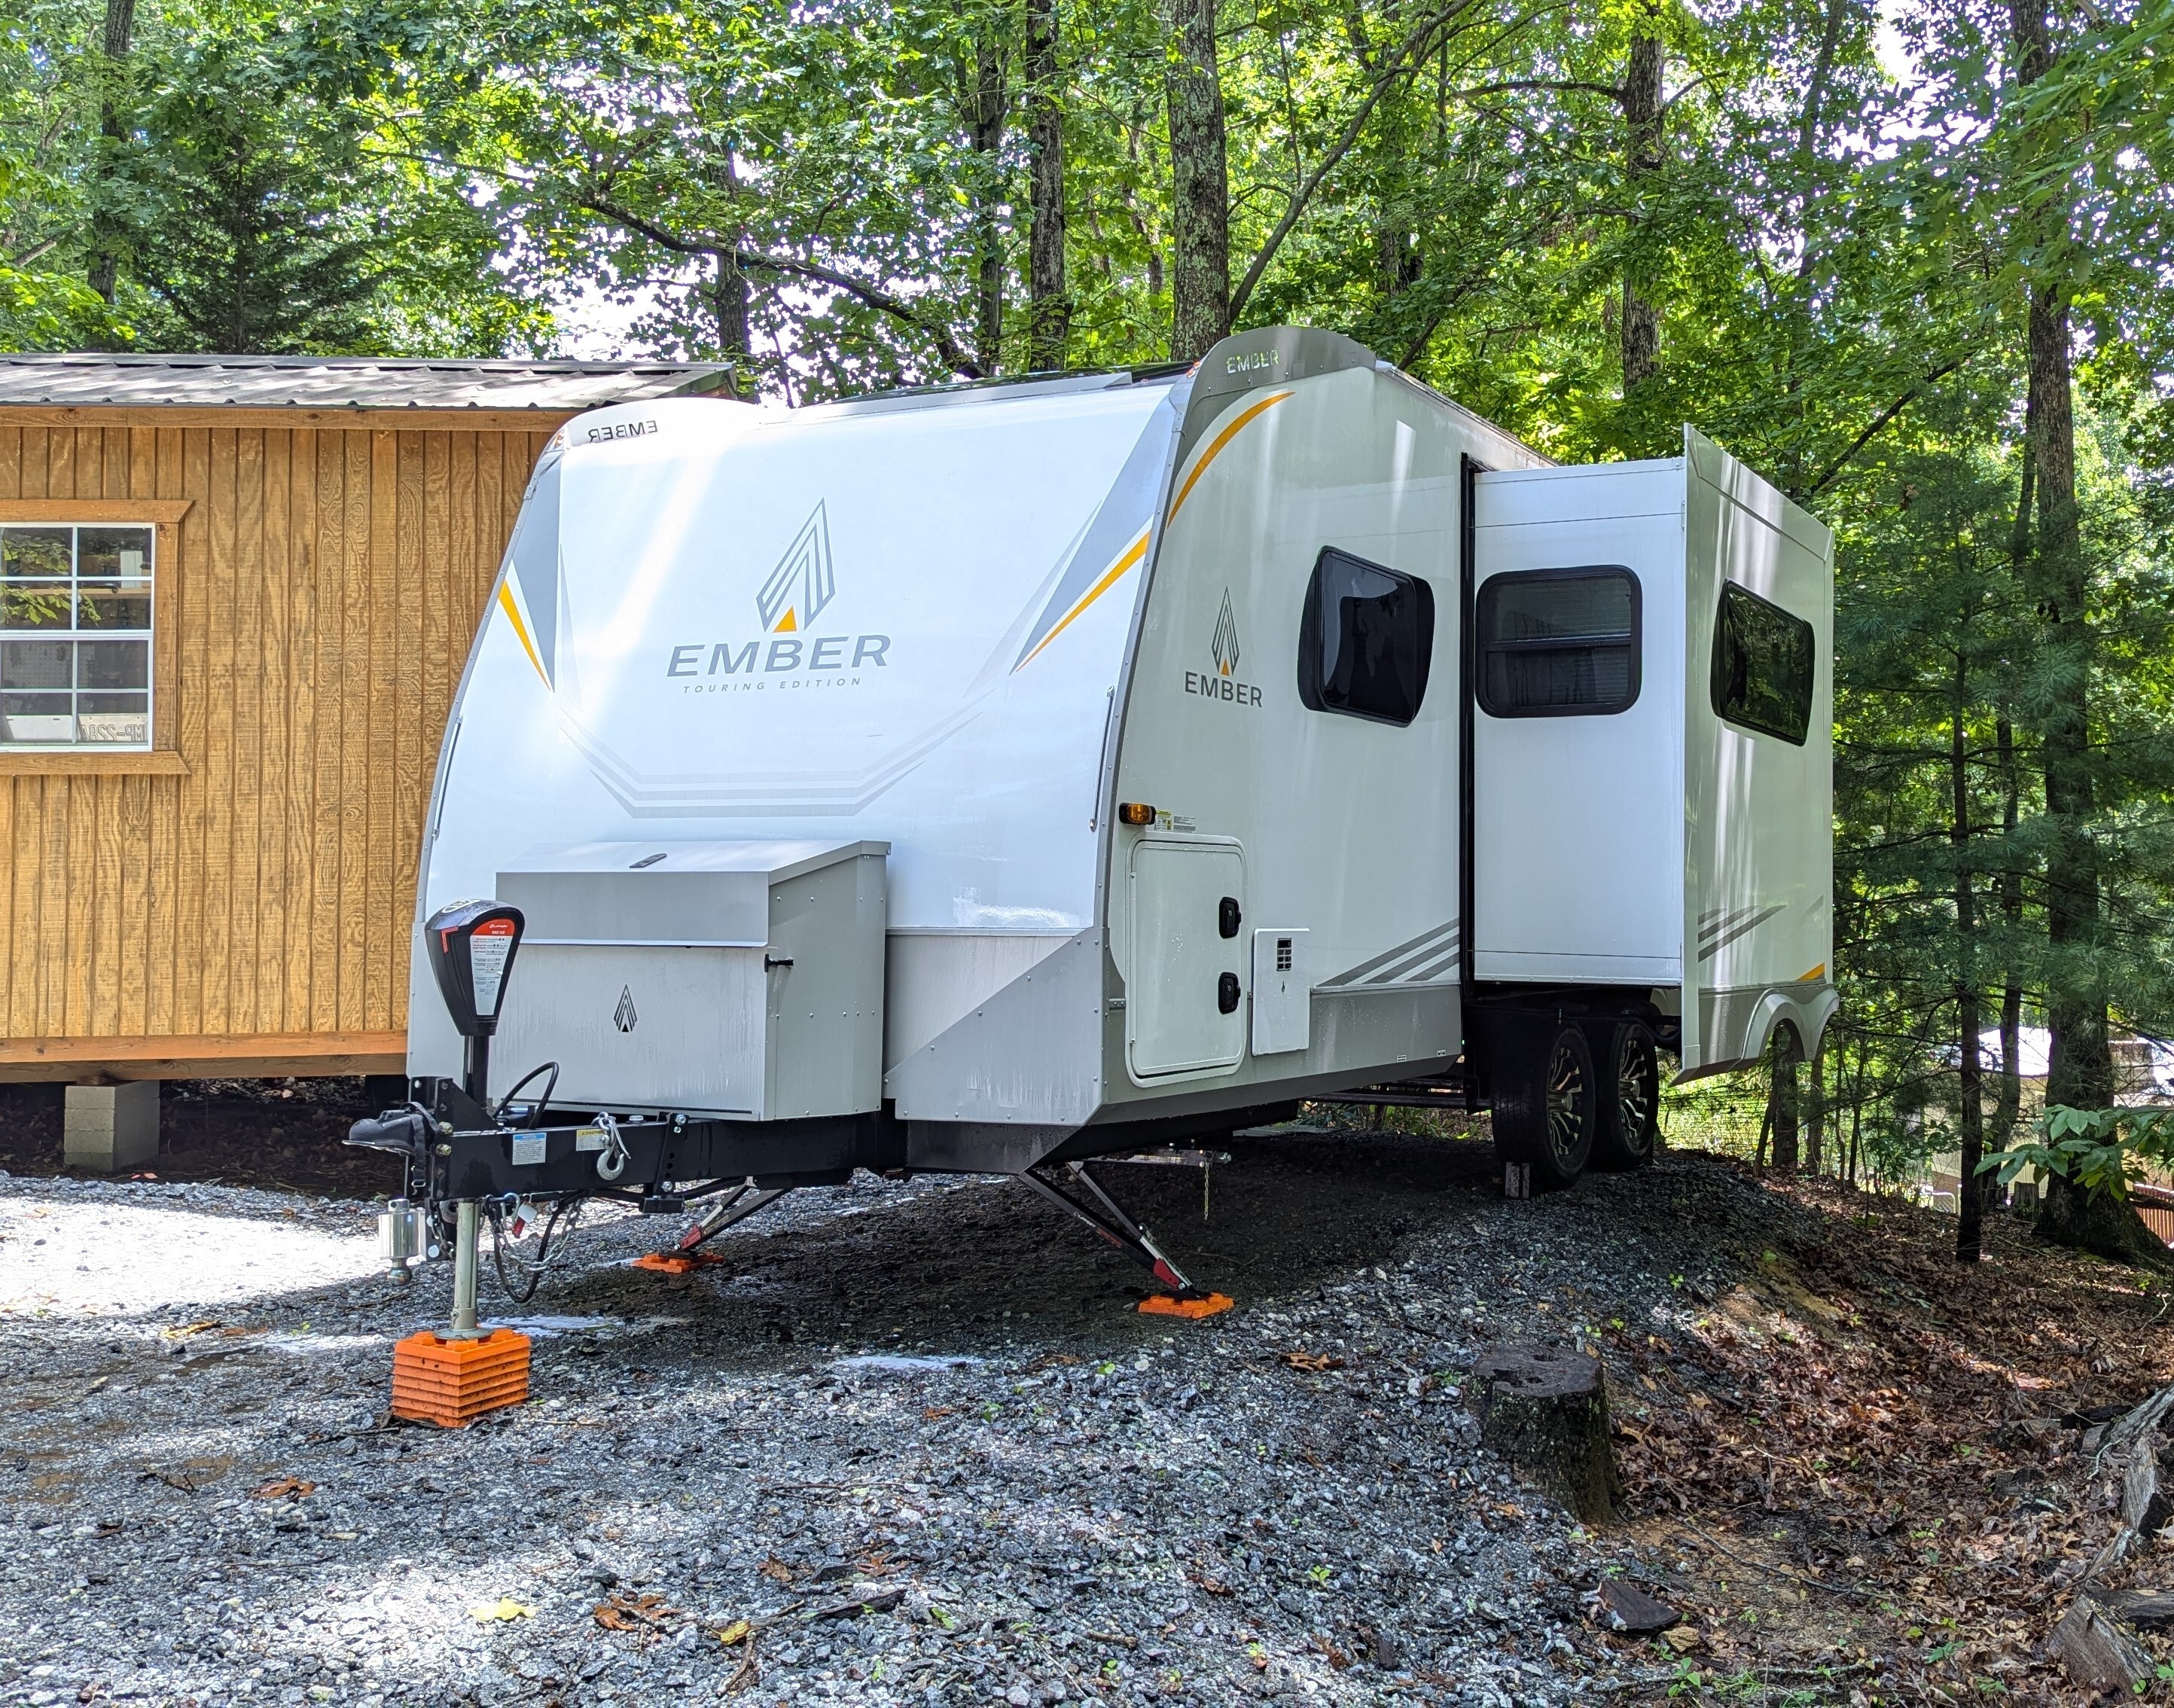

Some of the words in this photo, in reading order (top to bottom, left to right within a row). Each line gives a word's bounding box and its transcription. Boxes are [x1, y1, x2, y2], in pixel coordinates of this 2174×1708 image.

[1227, 350, 1279, 374] EMBER
[667, 635, 891, 677] EMBER
[684, 682, 766, 694] TOURING
[779, 678, 861, 689] EDITION
[1185, 671, 1263, 708] EMBER
